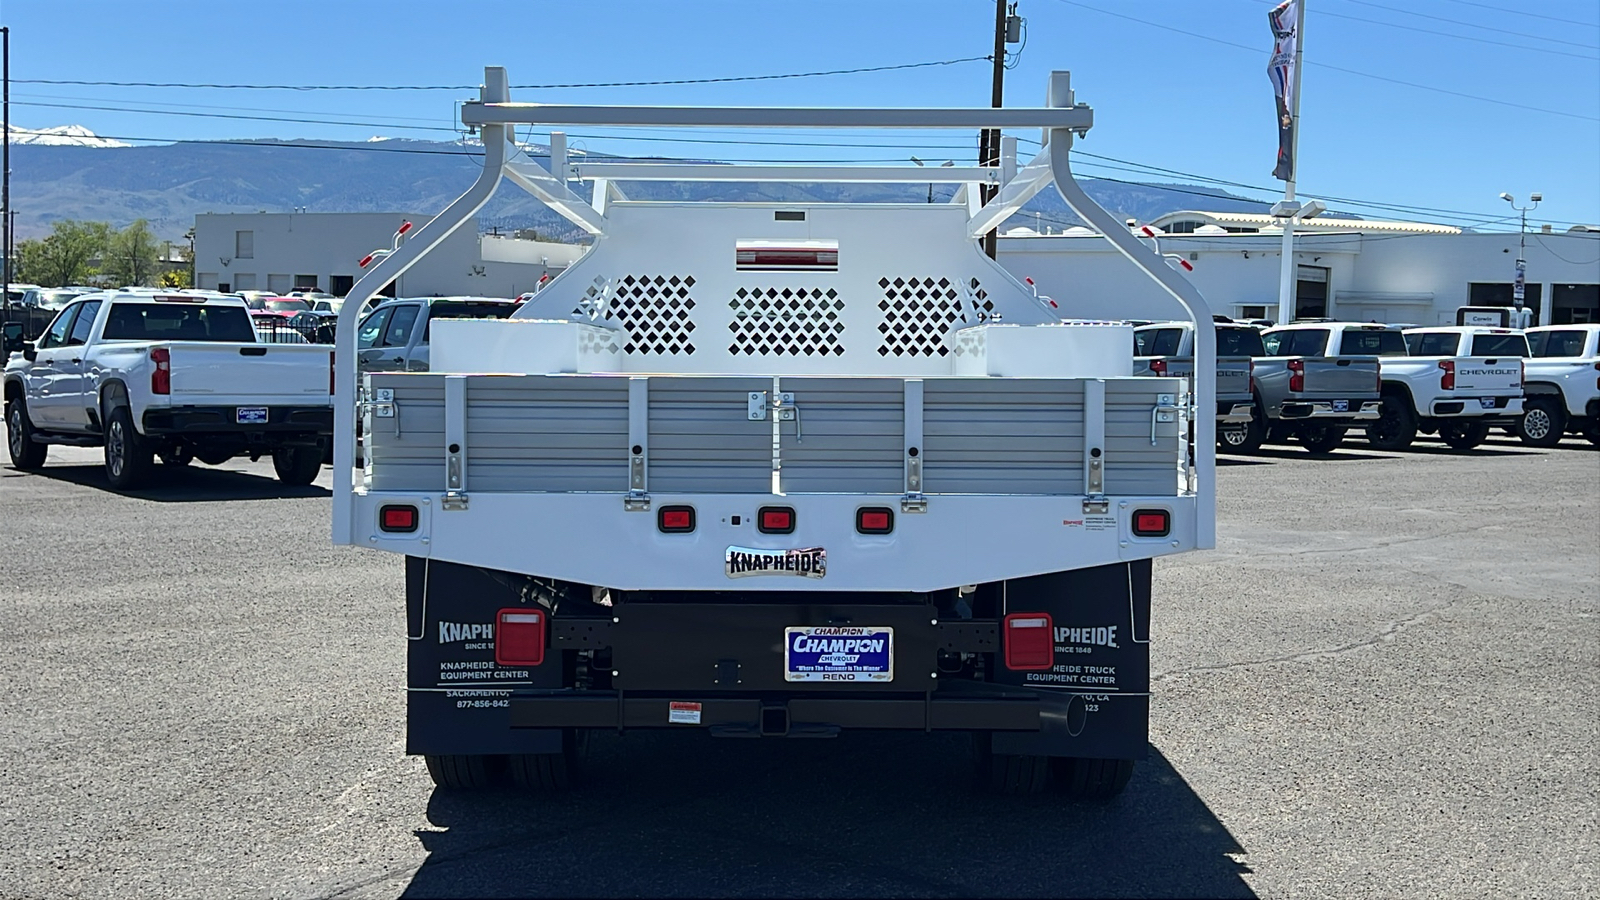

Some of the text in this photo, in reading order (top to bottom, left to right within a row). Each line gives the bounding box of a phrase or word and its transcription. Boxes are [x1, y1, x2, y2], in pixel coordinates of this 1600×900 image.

[730, 551, 822, 574] KNAPHEIDE
[438, 621, 495, 644] KNAPH
[814, 627, 864, 635] CHAMPION
[793, 635, 884, 653] CHAMPION
[440, 662, 495, 670] KNAPHEIDE
[1053, 665, 1116, 674] HEIDE TRUCK
[440, 671, 529, 680] EQUIPMENT CENTER
[1026, 673, 1116, 684] EQUIPMENT CENTER
[446, 690, 510, 698] SACRAMENTO,
[1097, 694, 1110, 702] CA
[456, 700, 510, 708] 877-856-842
